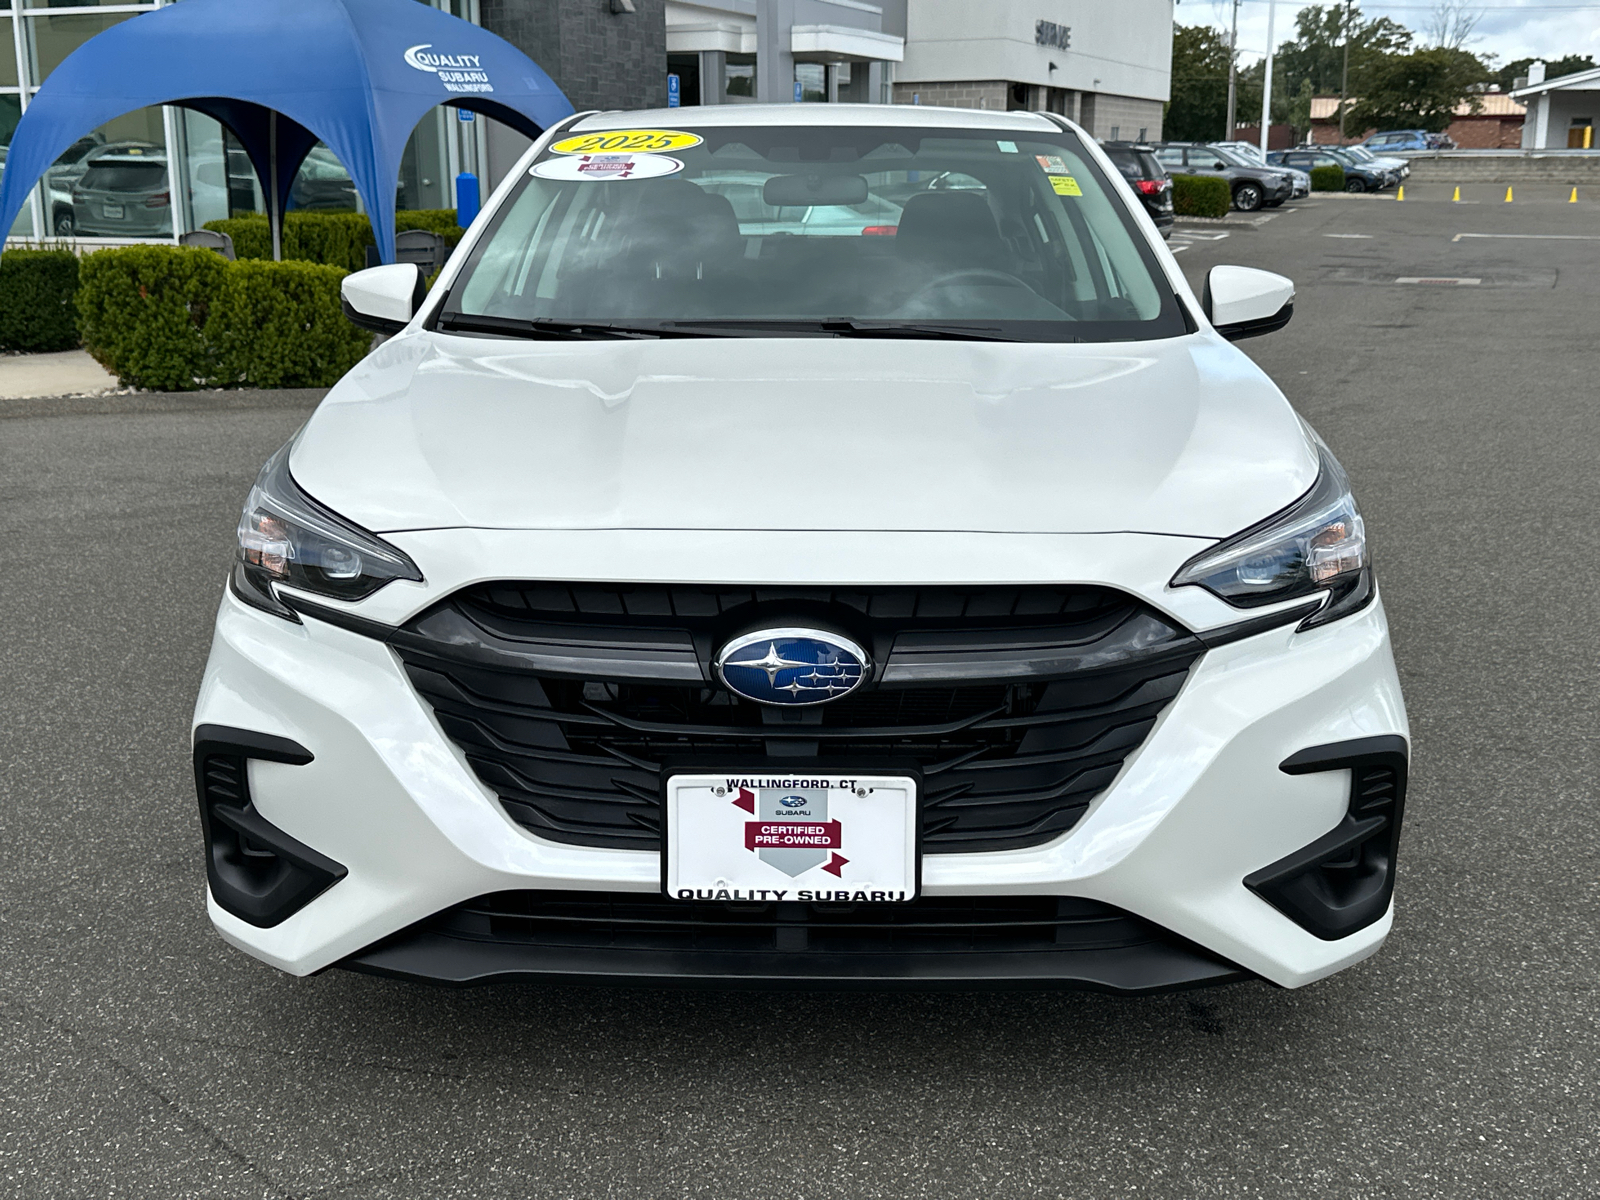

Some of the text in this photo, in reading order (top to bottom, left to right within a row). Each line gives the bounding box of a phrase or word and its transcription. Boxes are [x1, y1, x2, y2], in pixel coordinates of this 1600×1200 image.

[416, 52, 480, 67] QUALITY
[438, 71, 489, 82] SUBARU
[572, 134, 681, 152] 2025
[839, 779, 857, 789] CT
[761, 825, 825, 834] CERTIFIED
[755, 835, 831, 845] PRE-OWNED
[677, 889, 905, 901] QUALITY SUBARU
